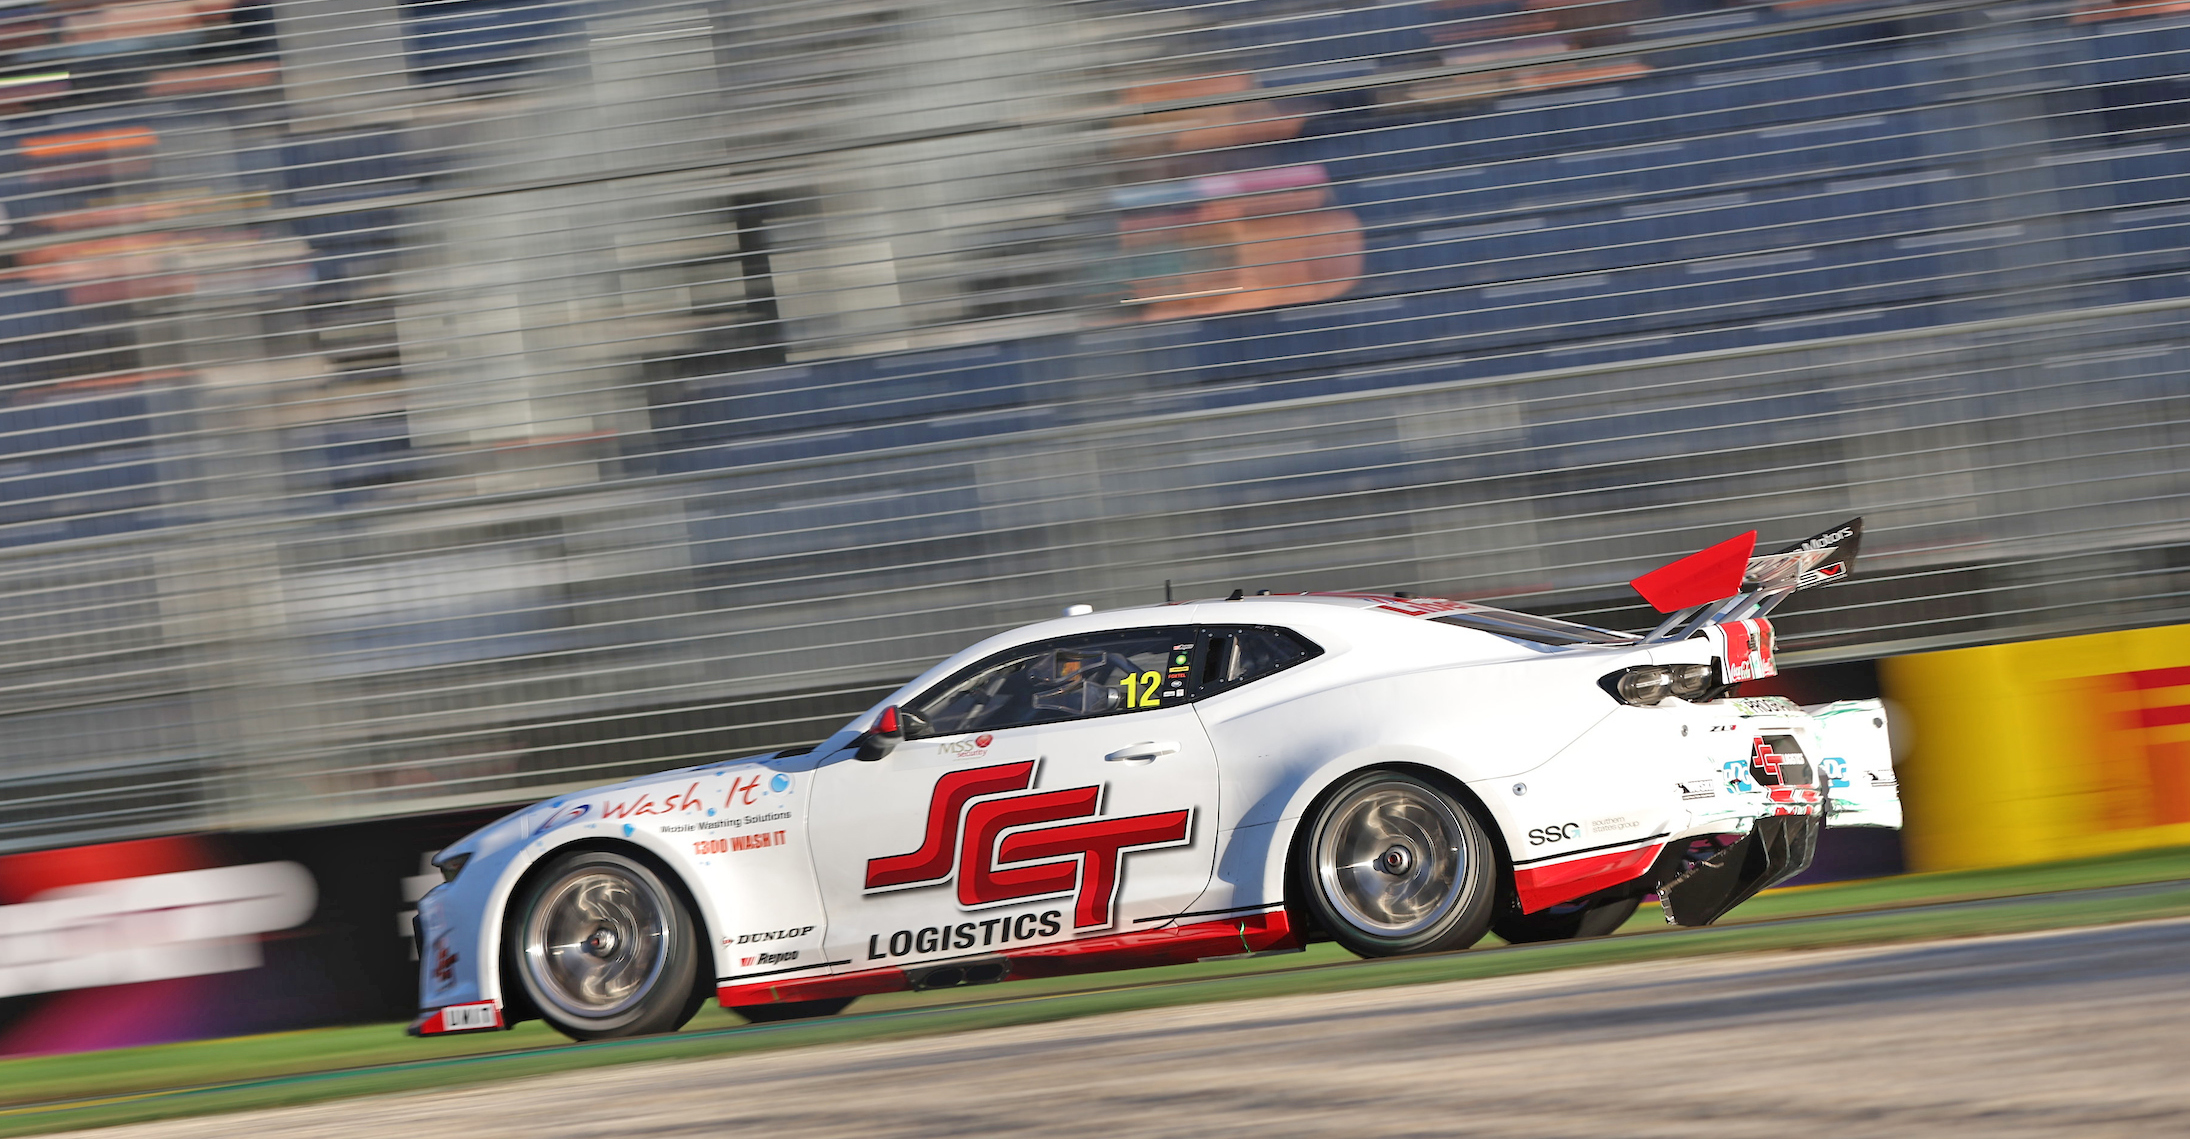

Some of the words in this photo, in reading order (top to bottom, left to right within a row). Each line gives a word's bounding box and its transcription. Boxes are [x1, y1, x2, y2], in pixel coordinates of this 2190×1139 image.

[1800, 526, 1854, 551] Motors
[1119, 670, 1162, 709] 12
[937, 739, 974, 755] MSS
[602, 781, 702, 819] Wash
[724, 774, 761, 809] It
[660, 825, 696, 833] Mobile
[697, 819, 742, 830] Washing
[744, 811, 792, 825] Solutions
[1617, 820, 1640, 831] group
[692, 838, 728, 855] 1300
[730, 833, 771, 852] WASH
[774, 830, 787, 846] IT
[863, 757, 1194, 935] SCT
[736, 925, 817, 945] DUNLOP
[867, 910, 1062, 961] LOGISTICS
[757, 950, 800, 966] Repco
